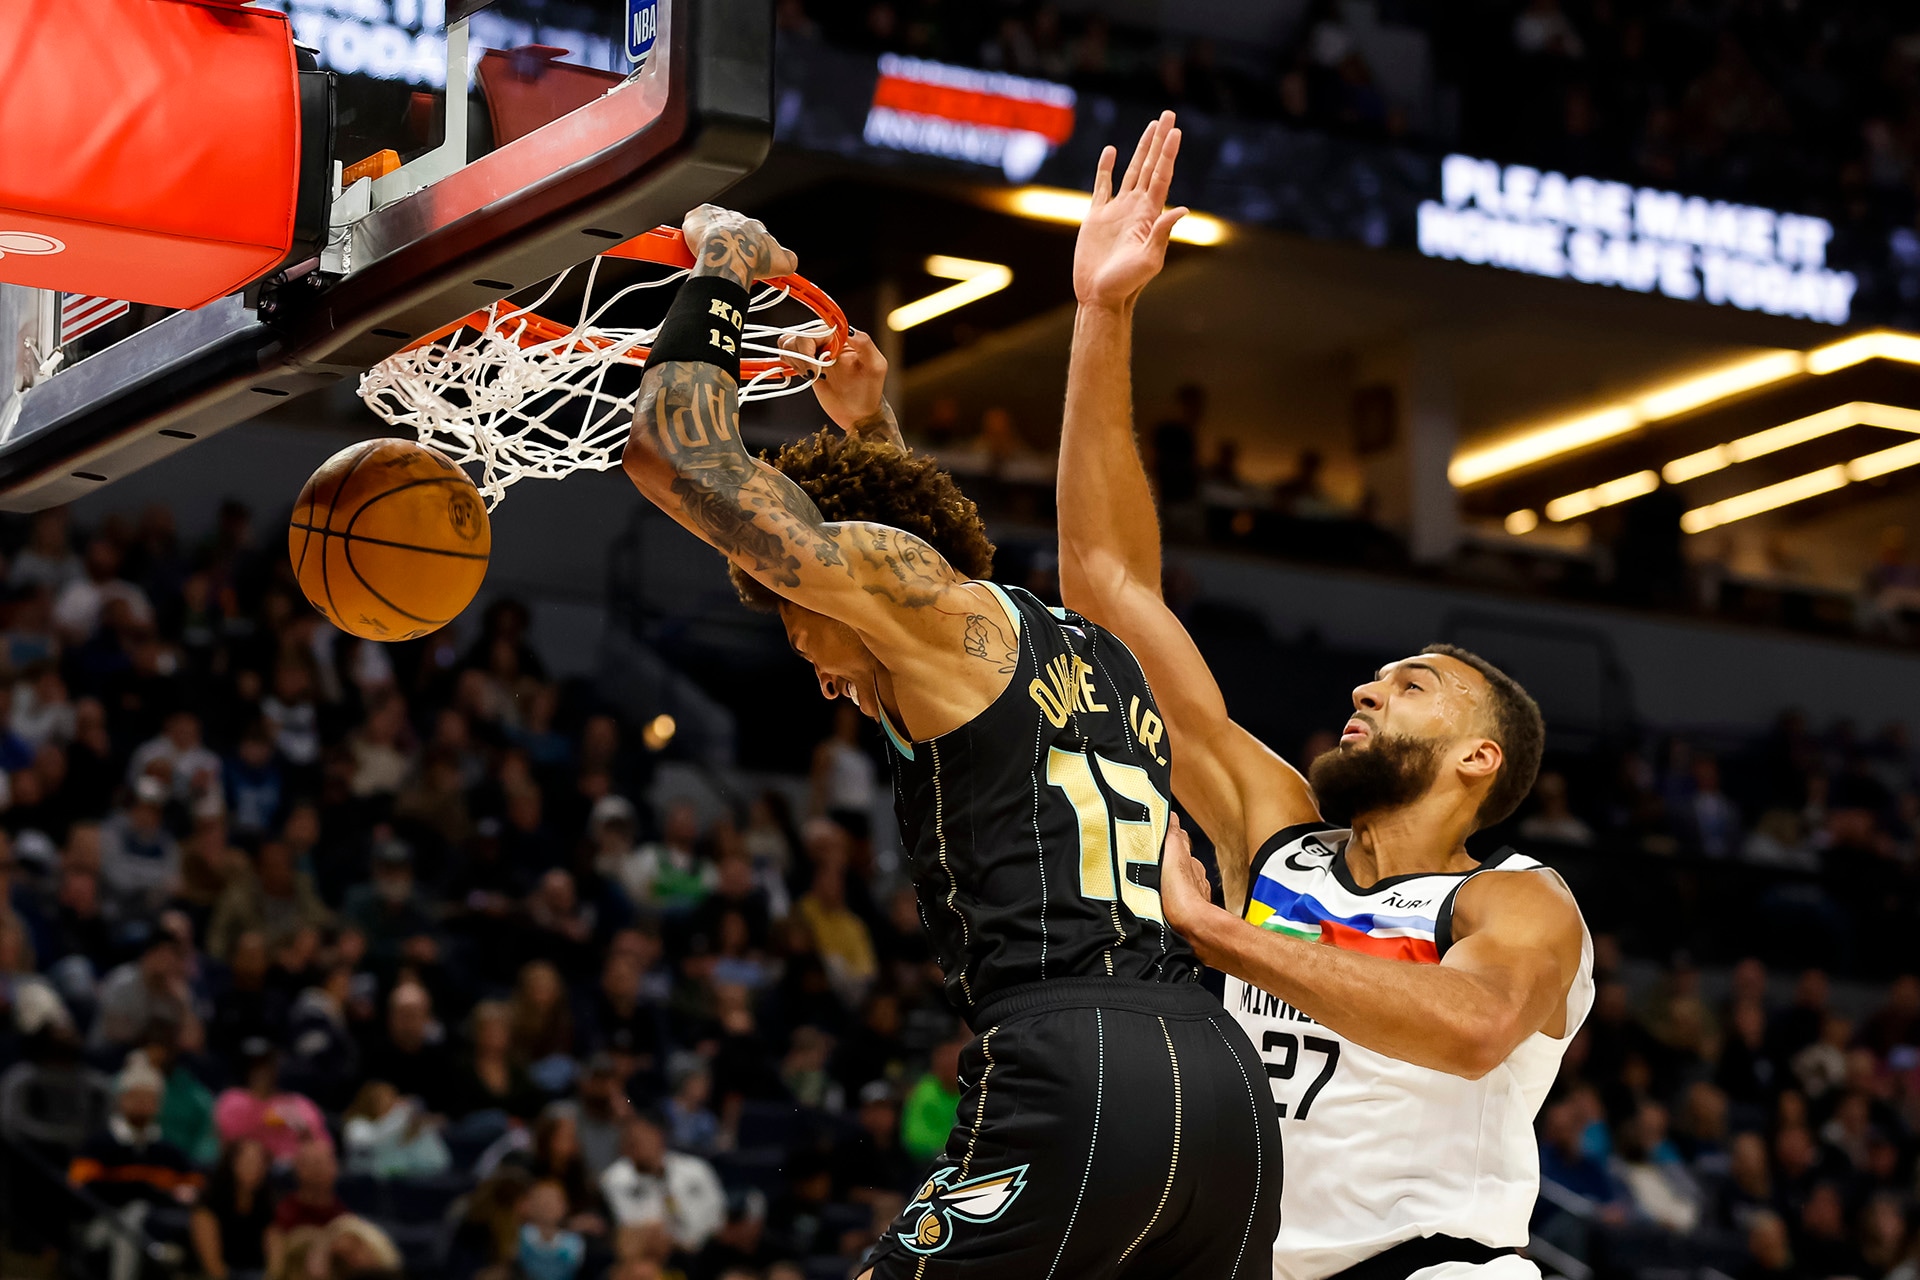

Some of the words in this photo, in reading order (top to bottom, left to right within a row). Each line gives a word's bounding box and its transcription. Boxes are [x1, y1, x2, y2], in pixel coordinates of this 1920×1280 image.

[633, 4, 656, 47] NBA
[1442, 154, 1632, 235] PLEASE
[1634, 188, 1776, 262] MAKE
[1777, 212, 1833, 268] IT
[1418, 200, 1567, 279] HOME
[1568, 228, 1699, 300] SAFE
[1702, 253, 1858, 326] TODAY
[709, 329, 736, 356] 12
[1047, 746, 1169, 928] 12
[1262, 1030, 1340, 1120] 27
